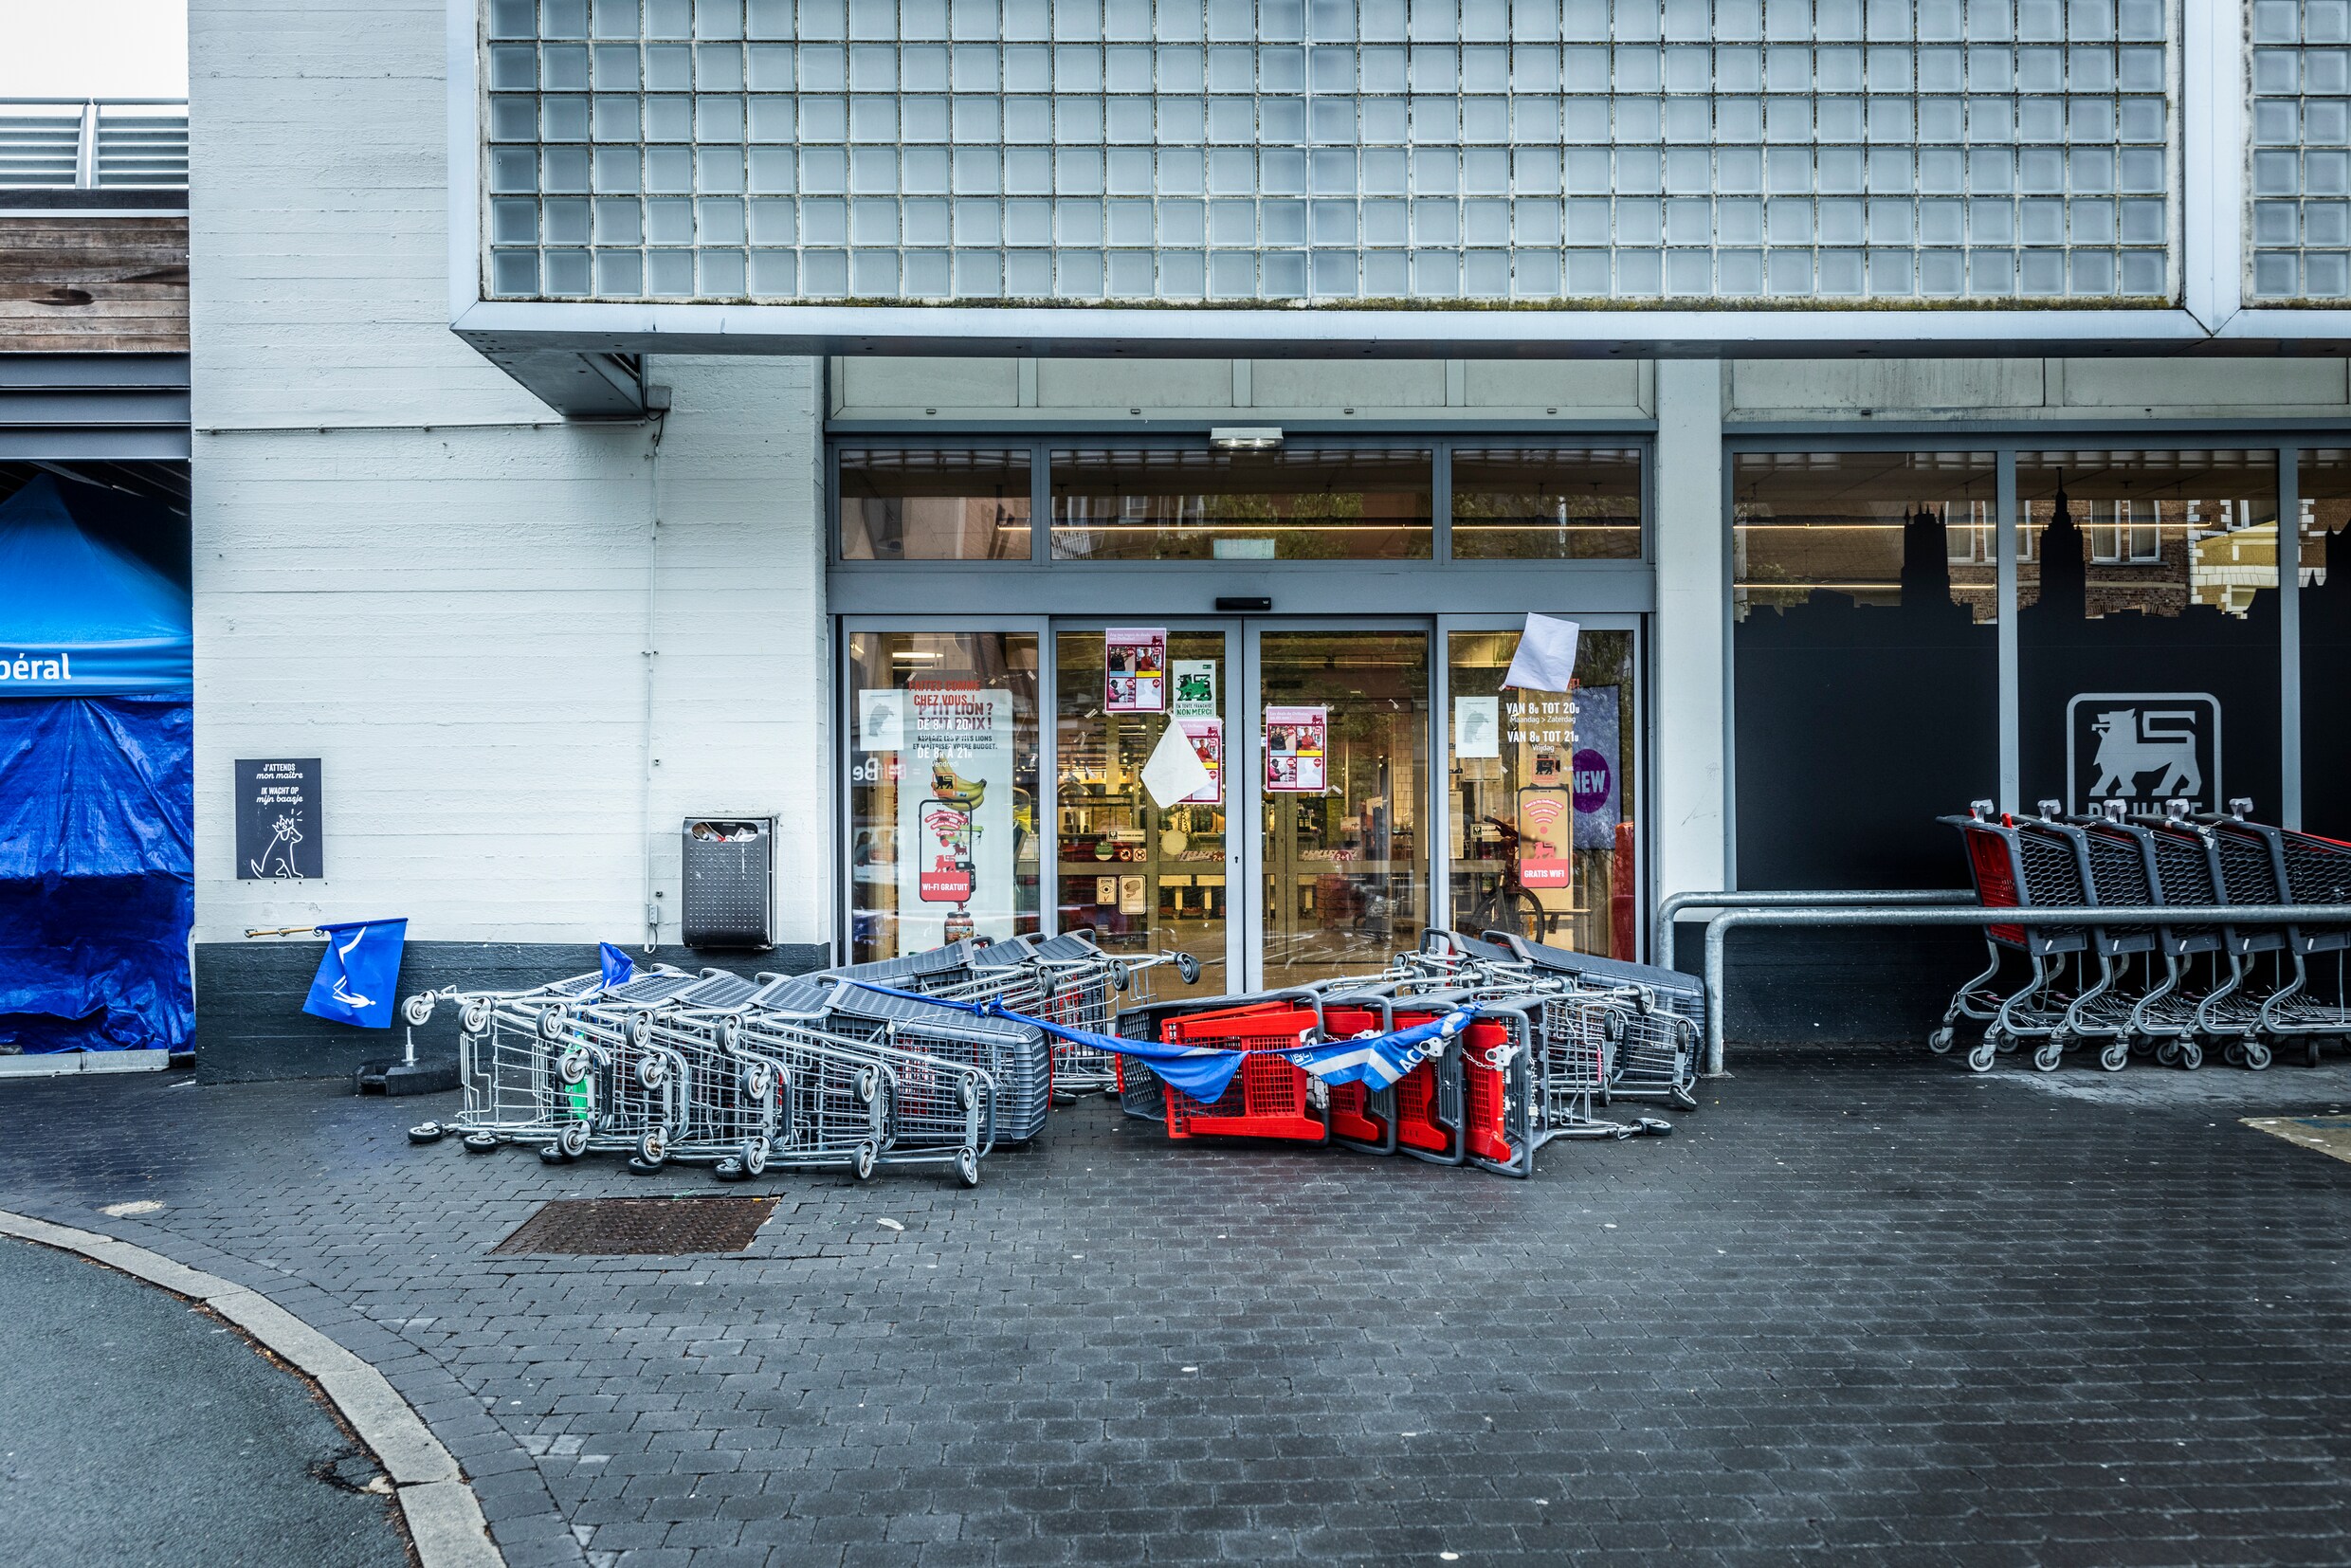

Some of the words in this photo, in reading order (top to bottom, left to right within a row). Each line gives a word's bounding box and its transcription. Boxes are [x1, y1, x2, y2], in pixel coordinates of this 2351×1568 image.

[908, 680, 941, 692] FAITES
[944, 680, 980, 692] COMME
[913, 694, 939, 706] CHEZ
[942, 694, 968, 706] VOUS
[955, 702, 984, 716] LION
[986, 702, 993, 716] ?
[1506, 702, 1525, 715] VAN
[1541, 702, 1559, 715] TOT
[918, 719, 930, 731] DE
[1511, 716, 1540, 724] Maandag
[1547, 716, 1576, 724] Zaterdag
[1507, 731, 1526, 743] VAN
[1542, 731, 1561, 743] TOT
[917, 747, 930, 758] DE
[1532, 743, 1555, 753] Vrijdag
[263, 763, 296, 772] J'ATTENDS
[276, 771, 303, 779] maître
[1572, 770, 1606, 793] NEW
[261, 787, 267, 795] IK
[268, 787, 290, 795] WACHT
[290, 786, 299, 795] OP
[256, 795, 275, 805] mijn
[276, 794, 303, 805] baasje
[1524, 869, 1548, 879] GRATIS
[921, 883, 939, 891] WI-FI
[940, 883, 968, 891] GRATUIT
